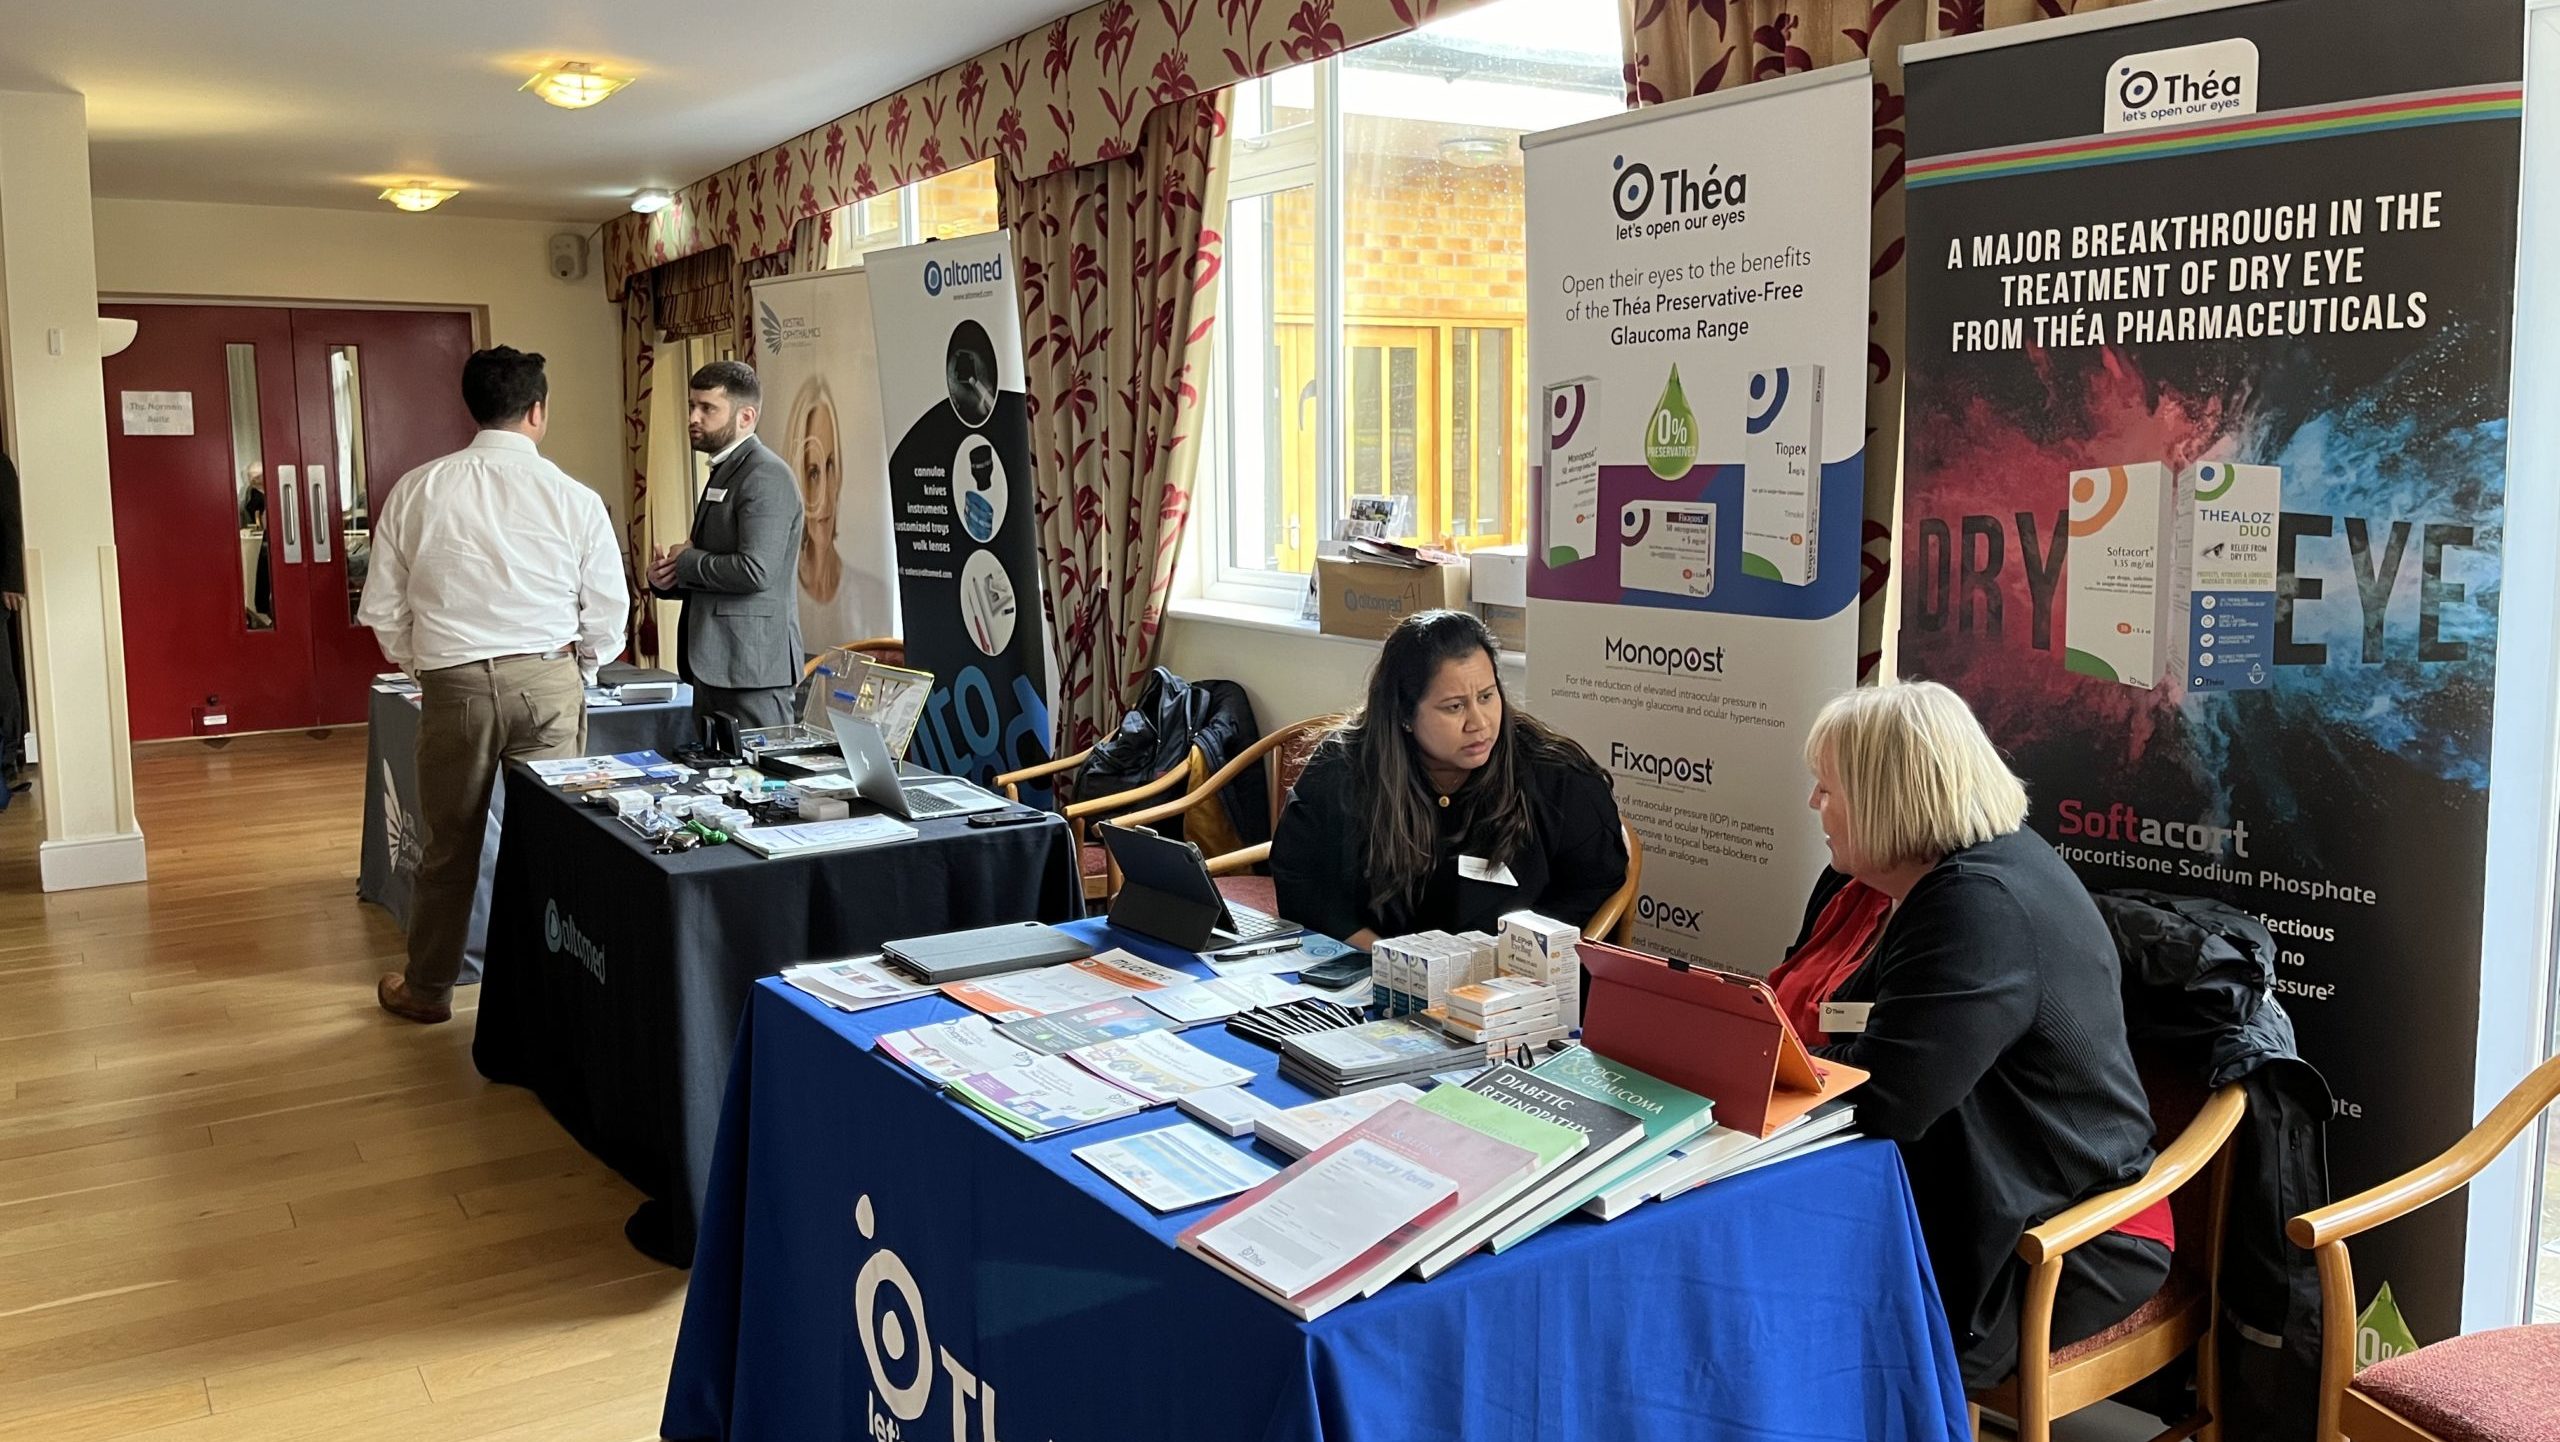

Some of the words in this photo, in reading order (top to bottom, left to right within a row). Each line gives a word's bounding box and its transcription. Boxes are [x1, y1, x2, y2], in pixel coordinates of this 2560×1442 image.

[2164, 70, 2241, 104] Théa
[2123, 111, 2146, 122] let's
[2151, 107, 2182, 120] open
[2186, 103, 2206, 113] our
[2211, 99, 2239, 113] eyes
[1661, 164, 1747, 215] Théa
[1616, 224, 1642, 240] let's
[1646, 219, 1680, 239] open
[1685, 216, 1707, 230] our
[1712, 209, 1745, 230] eyes
[1947, 238, 1963, 269] A
[1972, 229, 2061, 267] MAJOR
[2071, 203, 2316, 259] BREAKTHROUGH
[2330, 198, 2362, 236] IN
[2376, 191, 2442, 231] THE
[944, 253, 1001, 286] altomed
[1562, 274, 1604, 297] Open
[1610, 268, 1643, 289] their
[1648, 267, 1683, 289] eyes
[1689, 264, 1704, 279] to
[1710, 258, 1735, 276] the
[1742, 246, 1810, 273] benefits
[2001, 263, 2170, 307] TREATMENT
[2181, 260, 2217, 296] OF
[2229, 254, 2292, 292] DRY
[2303, 247, 2364, 287] EYE
[1566, 302, 1581, 321] of
[1586, 300, 1609, 318] the
[1613, 297, 1651, 316] Théa
[1656, 282, 1803, 312] Preservative-Free
[1611, 325, 1690, 345] Glaucoma
[1697, 319, 1749, 341] Range
[1952, 317, 2023, 352] FROM
[2034, 307, 2105, 348] THÉA
[2117, 292, 2427, 345] PHARMACEUTICALS
[1658, 409, 1687, 445] 0%
[1648, 446, 1695, 457] PRESERVATIVES
[1776, 442, 1806, 457] Tiopex
[915, 466, 945, 477] cannulae
[924, 485, 946, 496] knives
[907, 502, 948, 515] instruments
[2200, 510, 2271, 523] THEALOZ
[913, 540, 928, 550] volk
[929, 540, 950, 552] lenses
[932, 523, 949, 535] trays
[2240, 525, 2271, 537] DUO
[2107, 546, 2151, 557] Softacort
[2131, 560, 2154, 569] mg/ml
[2244, 553, 2256, 561] EYES
[2251, 544, 2267, 552] FROM
[1918, 510, 2069, 651] DRY
[2273, 512, 2474, 665] EYE
[1605, 636, 1723, 675] Monopost
[1552, 688, 1580, 699] patients
[1582, 691, 1597, 700] with
[1600, 694, 1644, 708] open-angle
[1646, 700, 1683, 713] glaucoma
[1686, 705, 1701, 715] and
[1704, 707, 1727, 719] ocular
[1730, 712, 1785, 728] hypertension
[1566, 675, 1578, 685] For
[1580, 677, 1592, 687] the
[1595, 680, 1631, 691] reduction
[1634, 683, 1641, 692] of
[1643, 685, 1676, 697] elevated
[1679, 690, 1720, 703] intraocular
[1723, 696, 1757, 709] pressure
[1760, 701, 1766, 710] in
[1610, 742, 1713, 785] Fixapost
[1622, 796, 1630, 805] of
[1632, 799, 1672, 813] intraocular
[1674, 807, 1708, 821] pressure
[1710, 812, 1729, 827] (IOP)
[1732, 818, 1739, 827] in
[1741, 822, 1774, 836] patients
[2058, 799, 2249, 858] Softacort
[1658, 817, 1672, 828] and
[1675, 821, 1698, 833] ocular
[1701, 826, 1752, 846] hypertension
[1755, 839, 1773, 851] who
[1664, 833, 1672, 843] to
[1674, 835, 1700, 848] topical
[1702, 839, 1757, 864] beta-blockers
[1759, 856, 1768, 865] or
[1669, 850, 1708, 866] analogues
[2178, 859, 2252, 886] Sodium
[2260, 871, 2377, 905] Phosphate
[1637, 895, 1700, 932] opex
[562, 914, 605, 985] altomed
[1648, 940, 1688, 958] intraocular
[2282, 950, 2305, 966] no
[1496, 1073, 1575, 1111] DIABETIC
[1591, 1066, 1626, 1084] OCT
[1581, 1074, 1665, 1115] GLAUCOMA
[1353, 1148, 1402, 1174] enquiry
[1401, 1170, 1435, 1190] form
